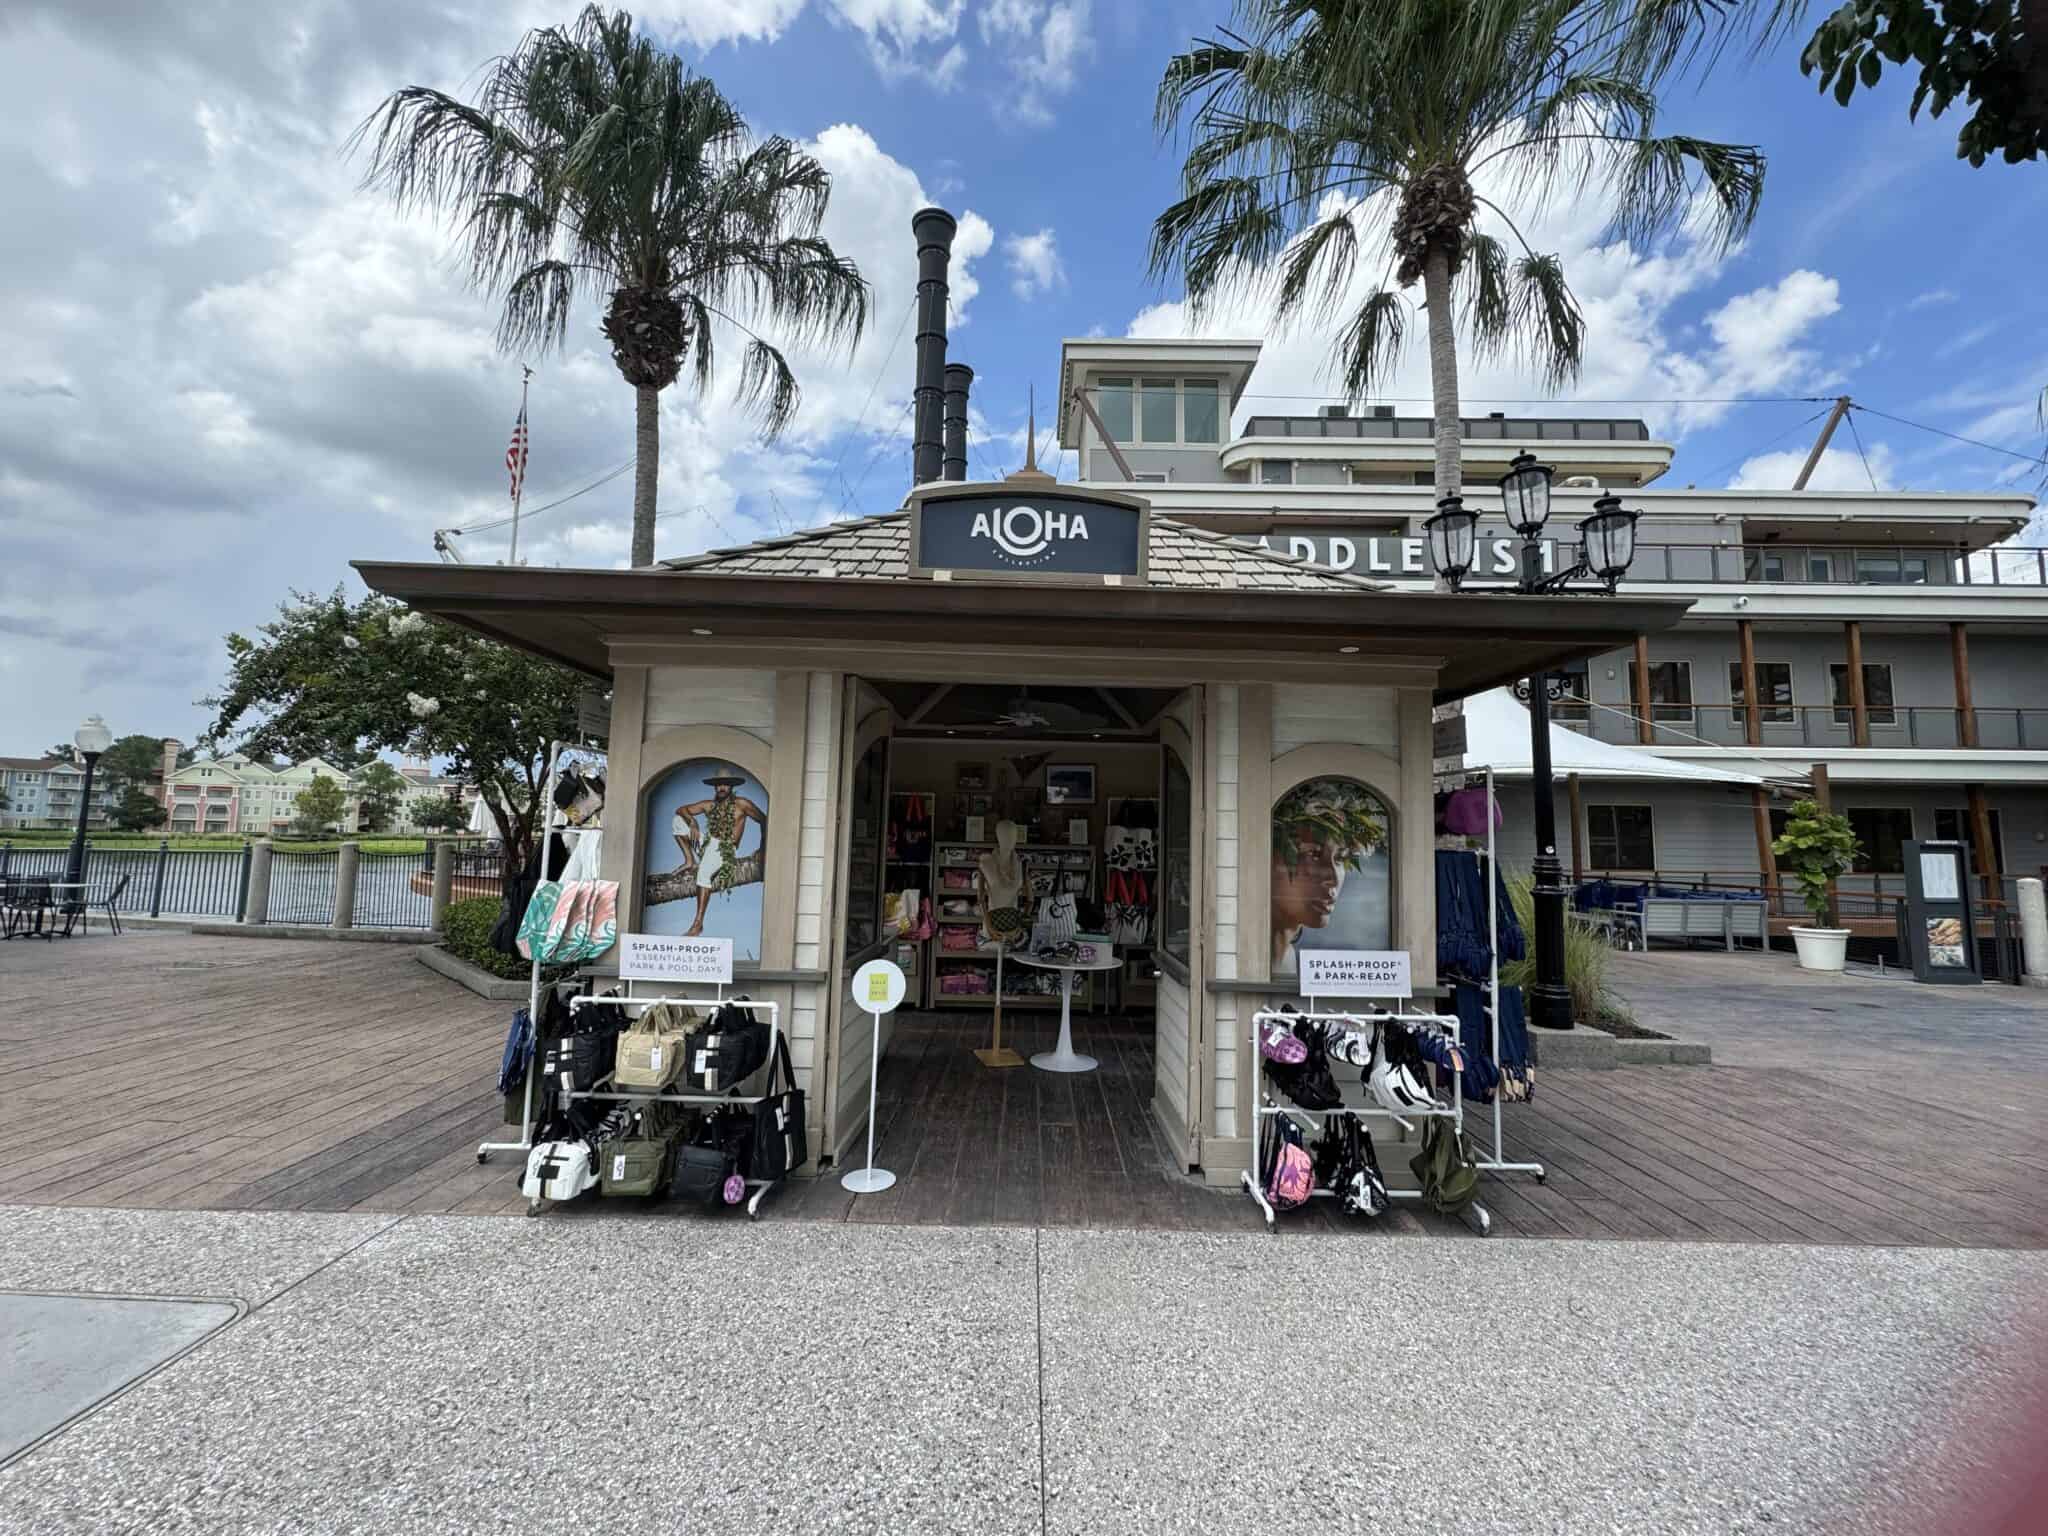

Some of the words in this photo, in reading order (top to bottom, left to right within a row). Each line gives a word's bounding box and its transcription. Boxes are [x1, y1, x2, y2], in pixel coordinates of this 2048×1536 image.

[970, 505, 1089, 556] ALOHA
[635, 953, 694, 963] ESSENTIALS
[697, 955, 717, 964] FOR
[630, 962, 654, 970] PARK
[667, 964, 694, 973] POOL
[697, 965, 722, 974] DAYS
[1314, 972, 1321, 980] &
[1325, 972, 1397, 980] PARK-READY
